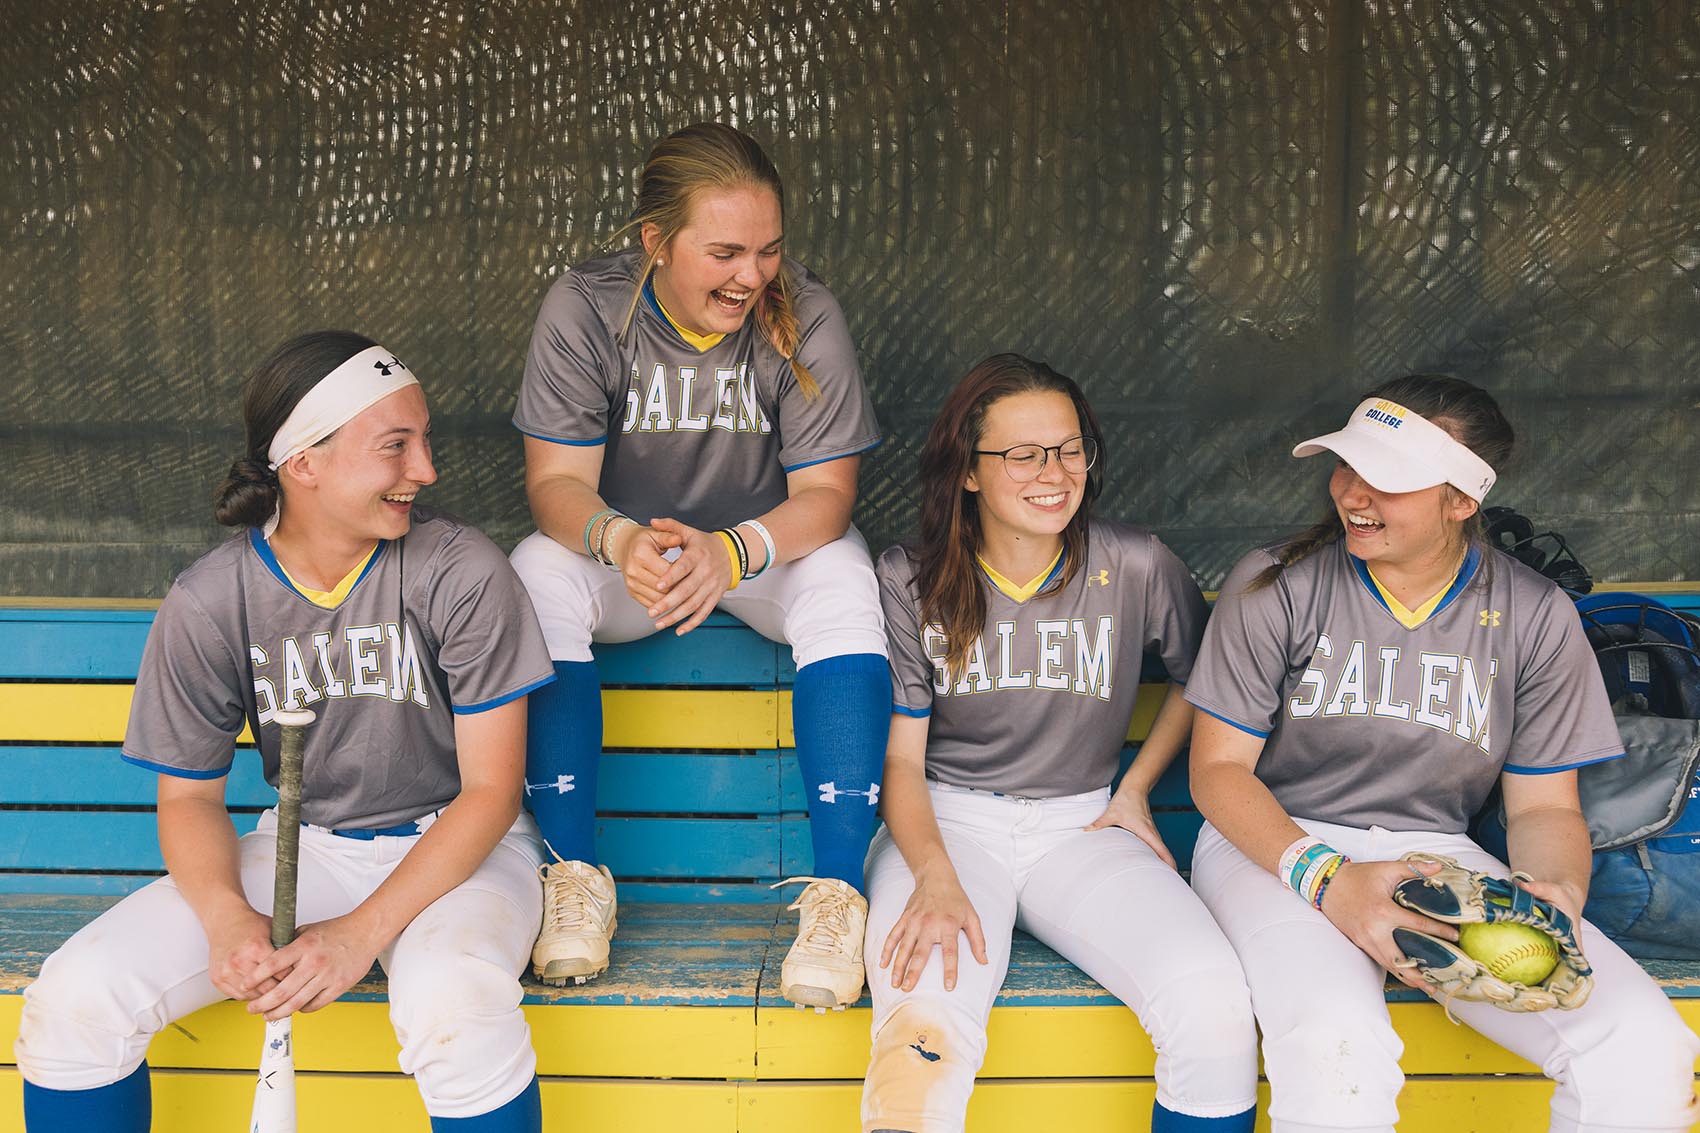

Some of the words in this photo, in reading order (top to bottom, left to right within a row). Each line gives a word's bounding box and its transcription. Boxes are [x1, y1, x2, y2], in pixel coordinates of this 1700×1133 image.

[1365, 409, 1403, 429] COLLEGE
[250, 620, 430, 727] SALEM
[920, 615, 1114, 702] SALEM
[1288, 633, 1498, 756] SALEM
